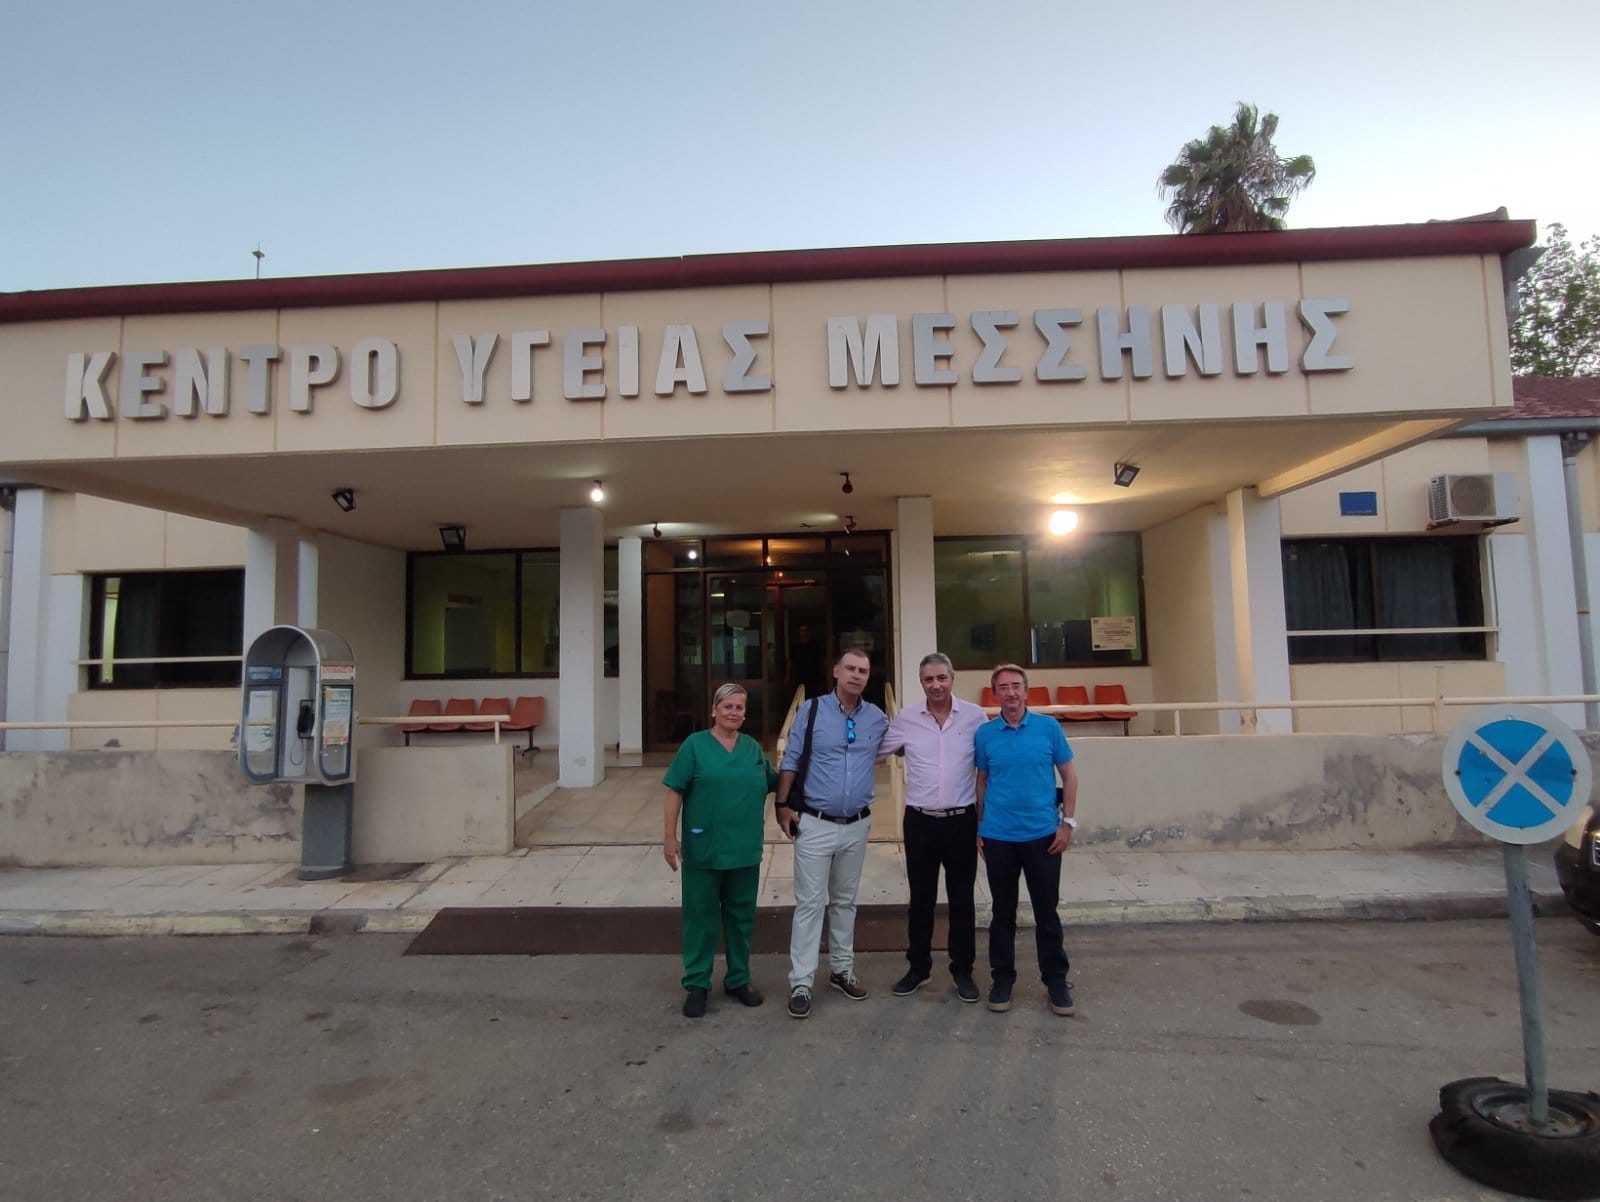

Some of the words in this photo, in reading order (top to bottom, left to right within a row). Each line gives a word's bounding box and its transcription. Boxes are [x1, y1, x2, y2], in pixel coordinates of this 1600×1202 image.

[65, 338, 399, 420] ΚΕΝΤΡΟ
[453, 321, 774, 404] ΥΓΕΙΑΣ
[827, 298, 1354, 389] ΜΕΣΣΗΝΗΣ
